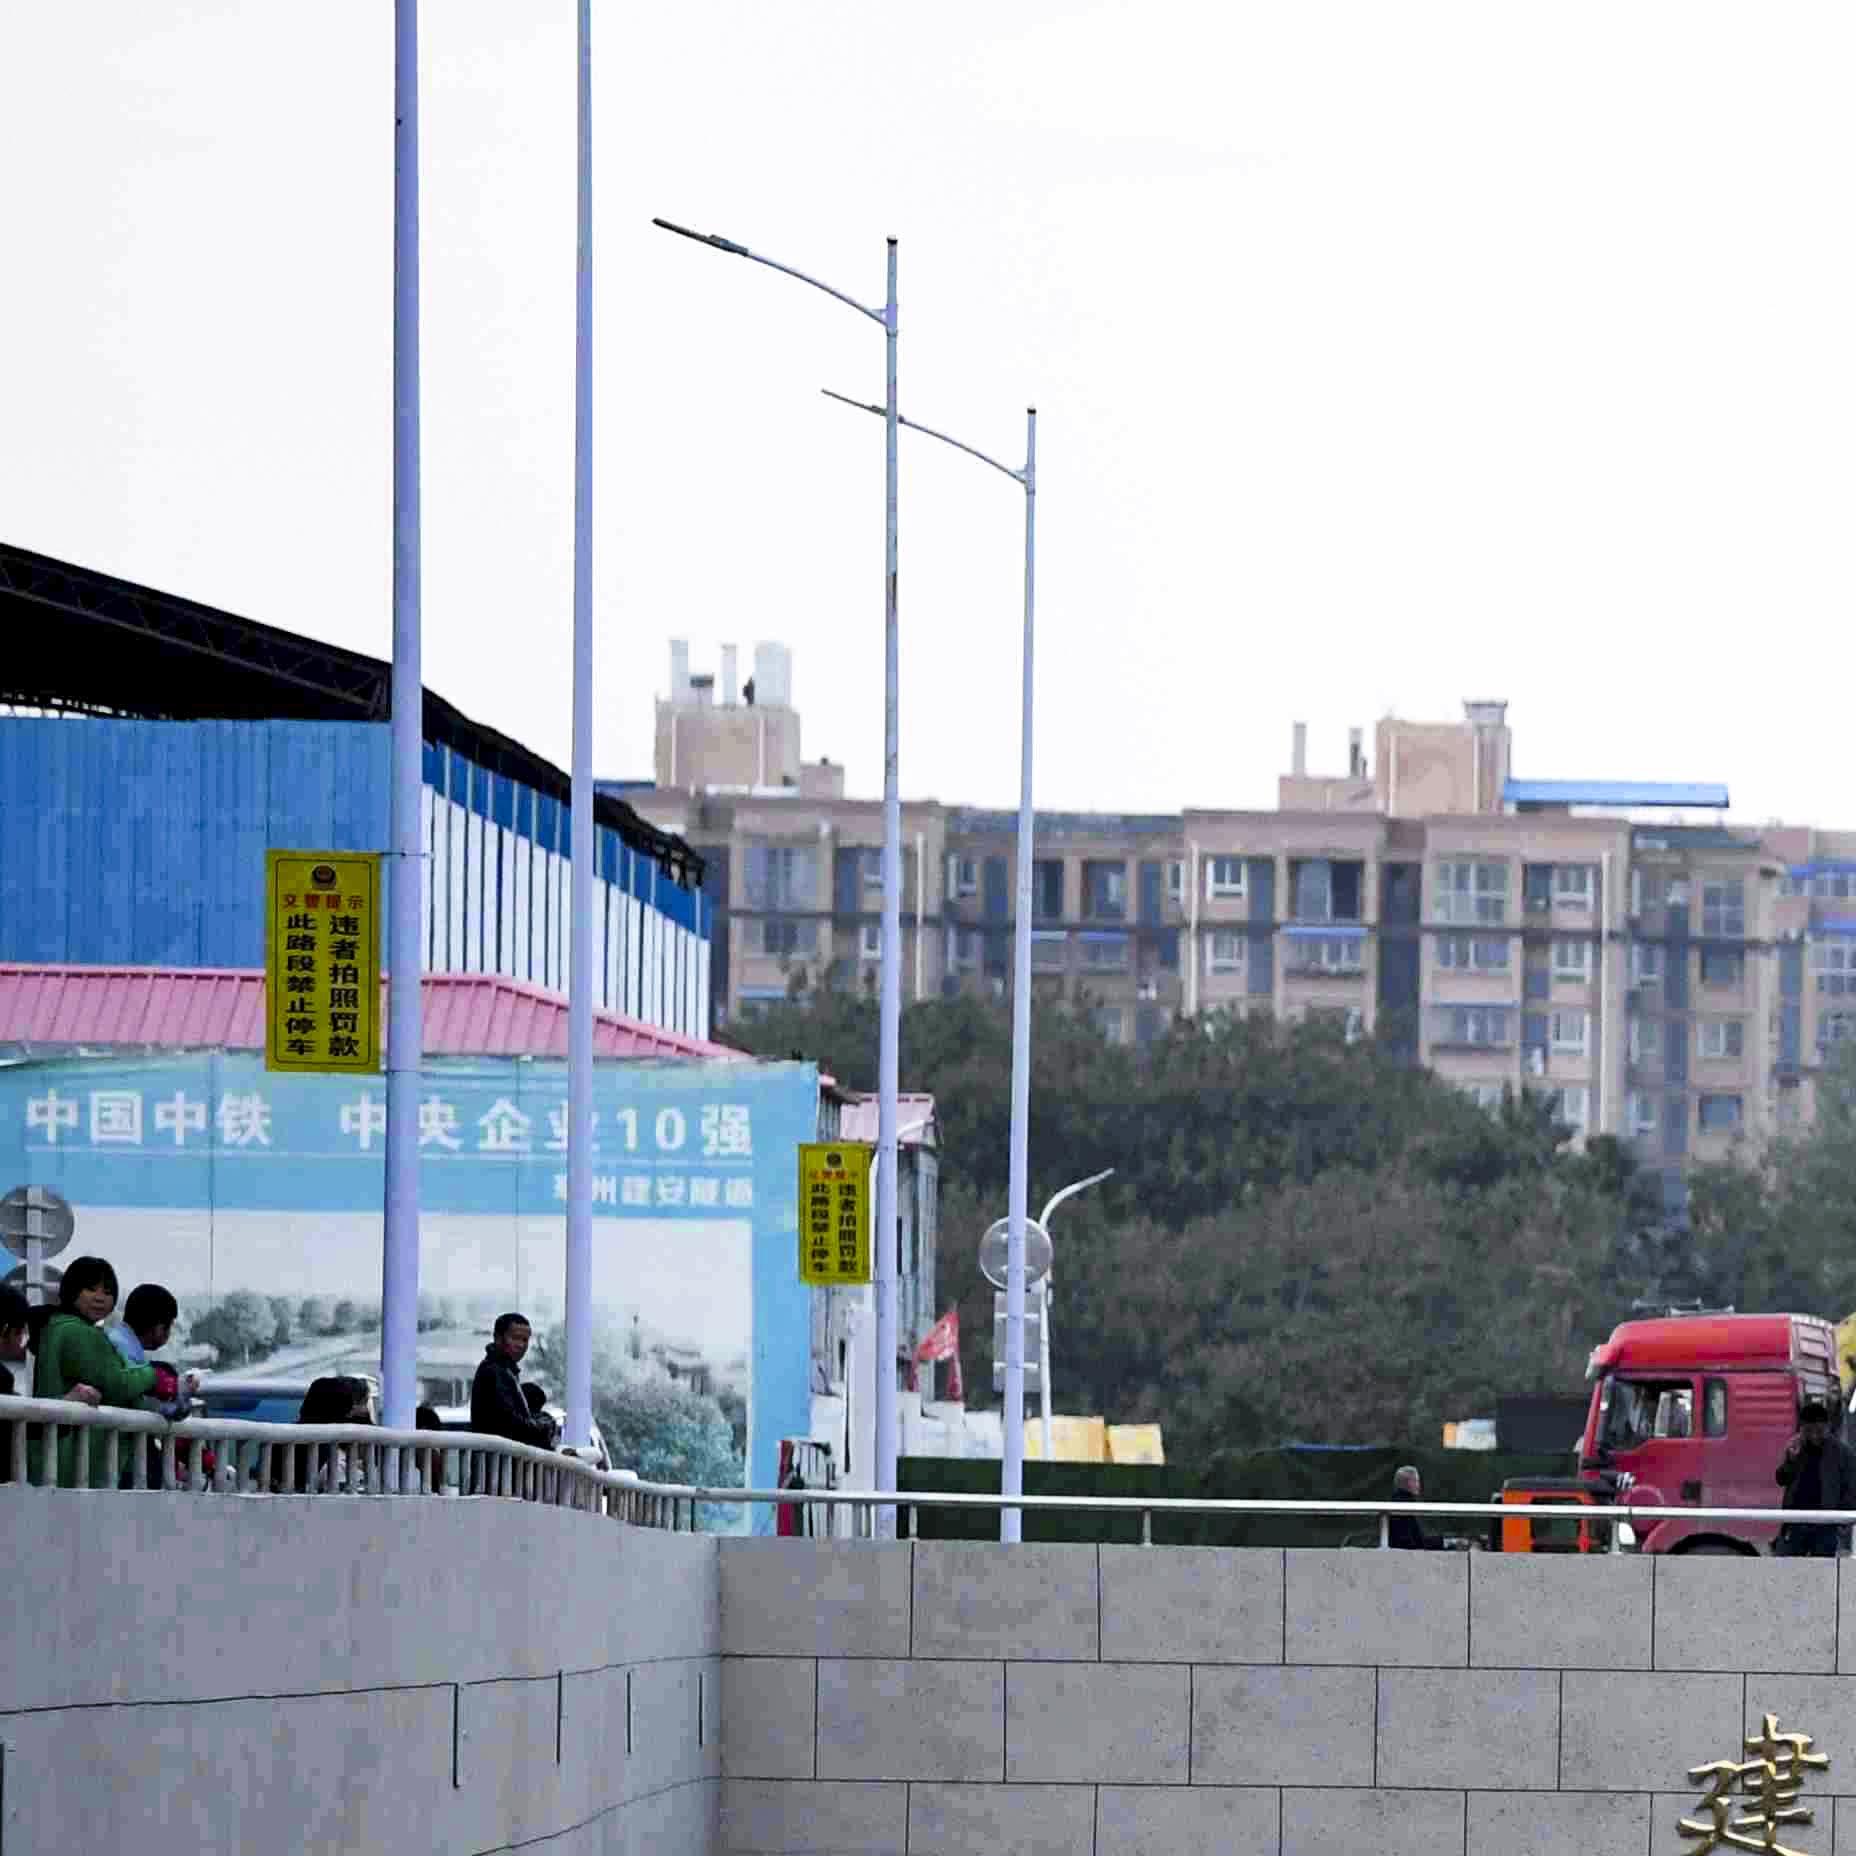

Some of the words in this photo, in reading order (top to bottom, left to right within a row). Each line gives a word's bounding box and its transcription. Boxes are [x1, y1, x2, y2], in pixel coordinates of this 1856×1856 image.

[286, 912, 317, 1056] 此路段禁止停车
[329, 915, 360, 1057] 违者拍照罚款
[26, 1086, 272, 1146] 中国中铁
